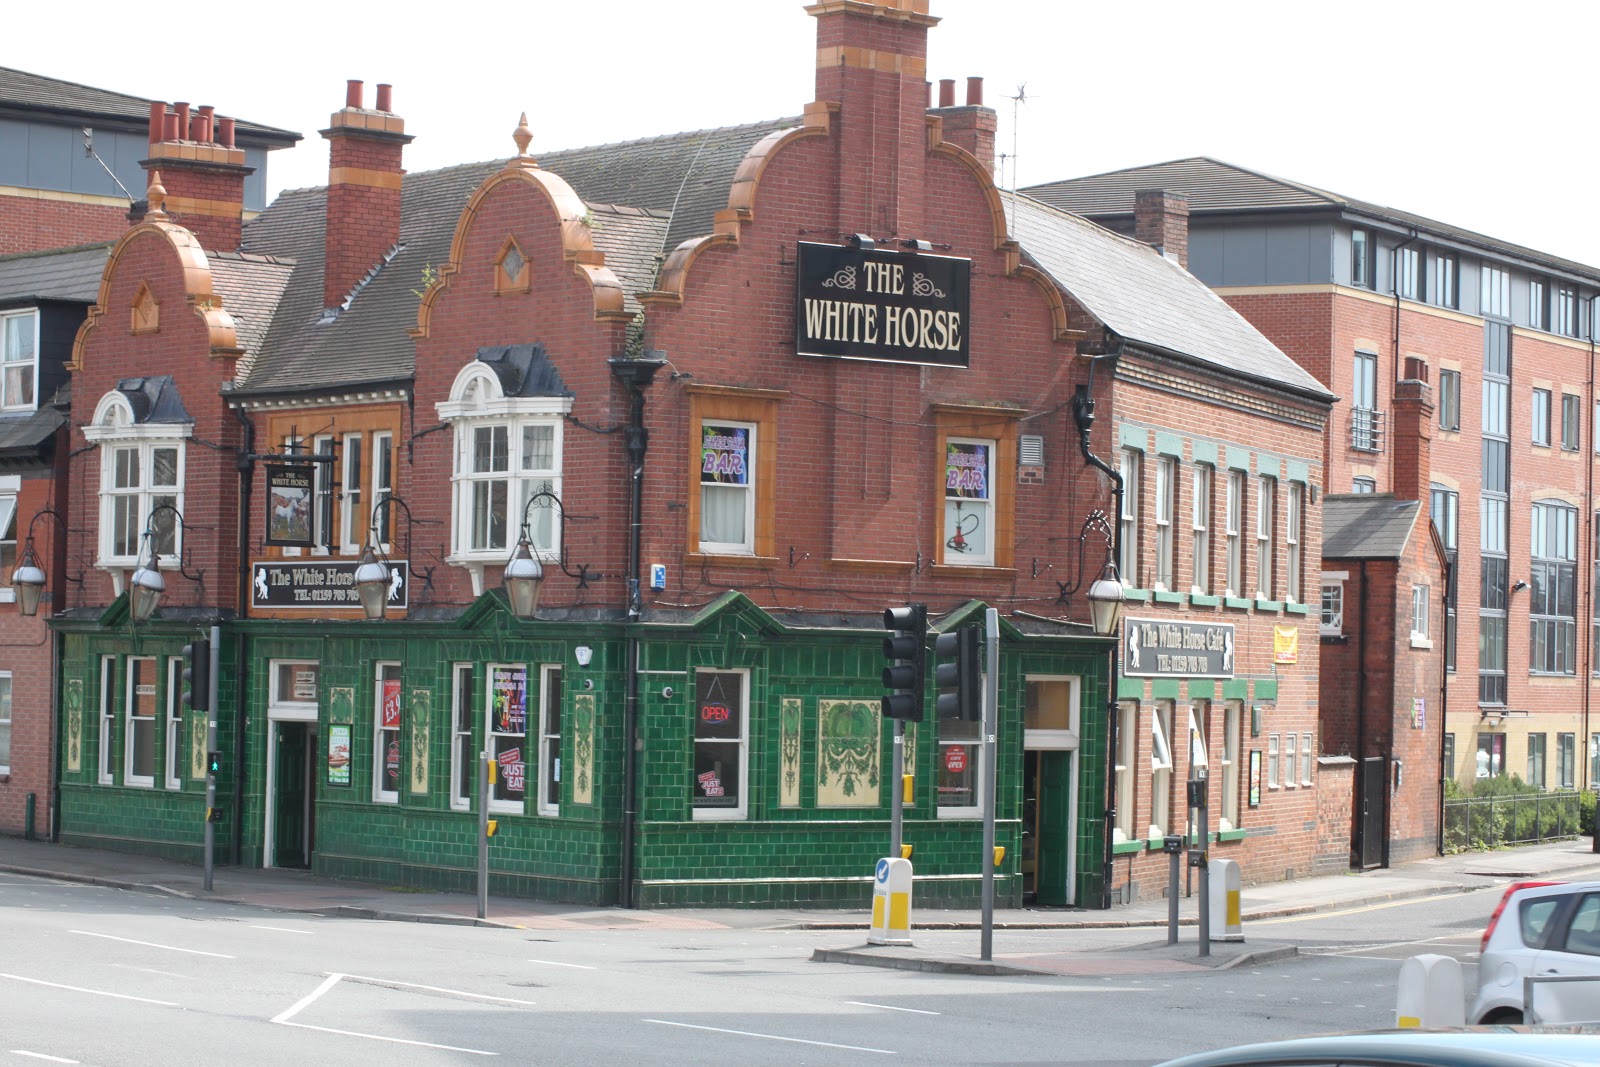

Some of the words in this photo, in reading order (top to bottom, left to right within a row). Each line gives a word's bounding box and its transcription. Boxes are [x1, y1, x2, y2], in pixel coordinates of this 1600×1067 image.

[863, 261, 905, 296] THE
[804, 298, 879, 344] WHITE
[884, 305, 962, 351] HORSE
[703, 435, 746, 450] SHEESHA
[703, 452, 743, 474] BAR
[947, 452, 986, 467] SHEESHA
[271, 477, 290, 486] WHITE
[947, 469, 984, 490] BAR
[270, 568, 291, 586] The
[292, 568, 325, 586] White
[326, 568, 354, 586] Hors
[294, 589, 311, 601] TEL:
[1141, 623, 1158, 648] The
[1158, 624, 1182, 649] White
[1182, 626, 1206, 650] Horse
[1206, 627, 1224, 652] Café
[1157, 654, 1171, 672] TEL:
[385, 693, 400, 723] £3.9
[702, 706, 729, 720] OPEN
[504, 763, 524, 775] JUST
[509, 776, 523, 788] EAT
[706, 787, 719, 795] EAT
